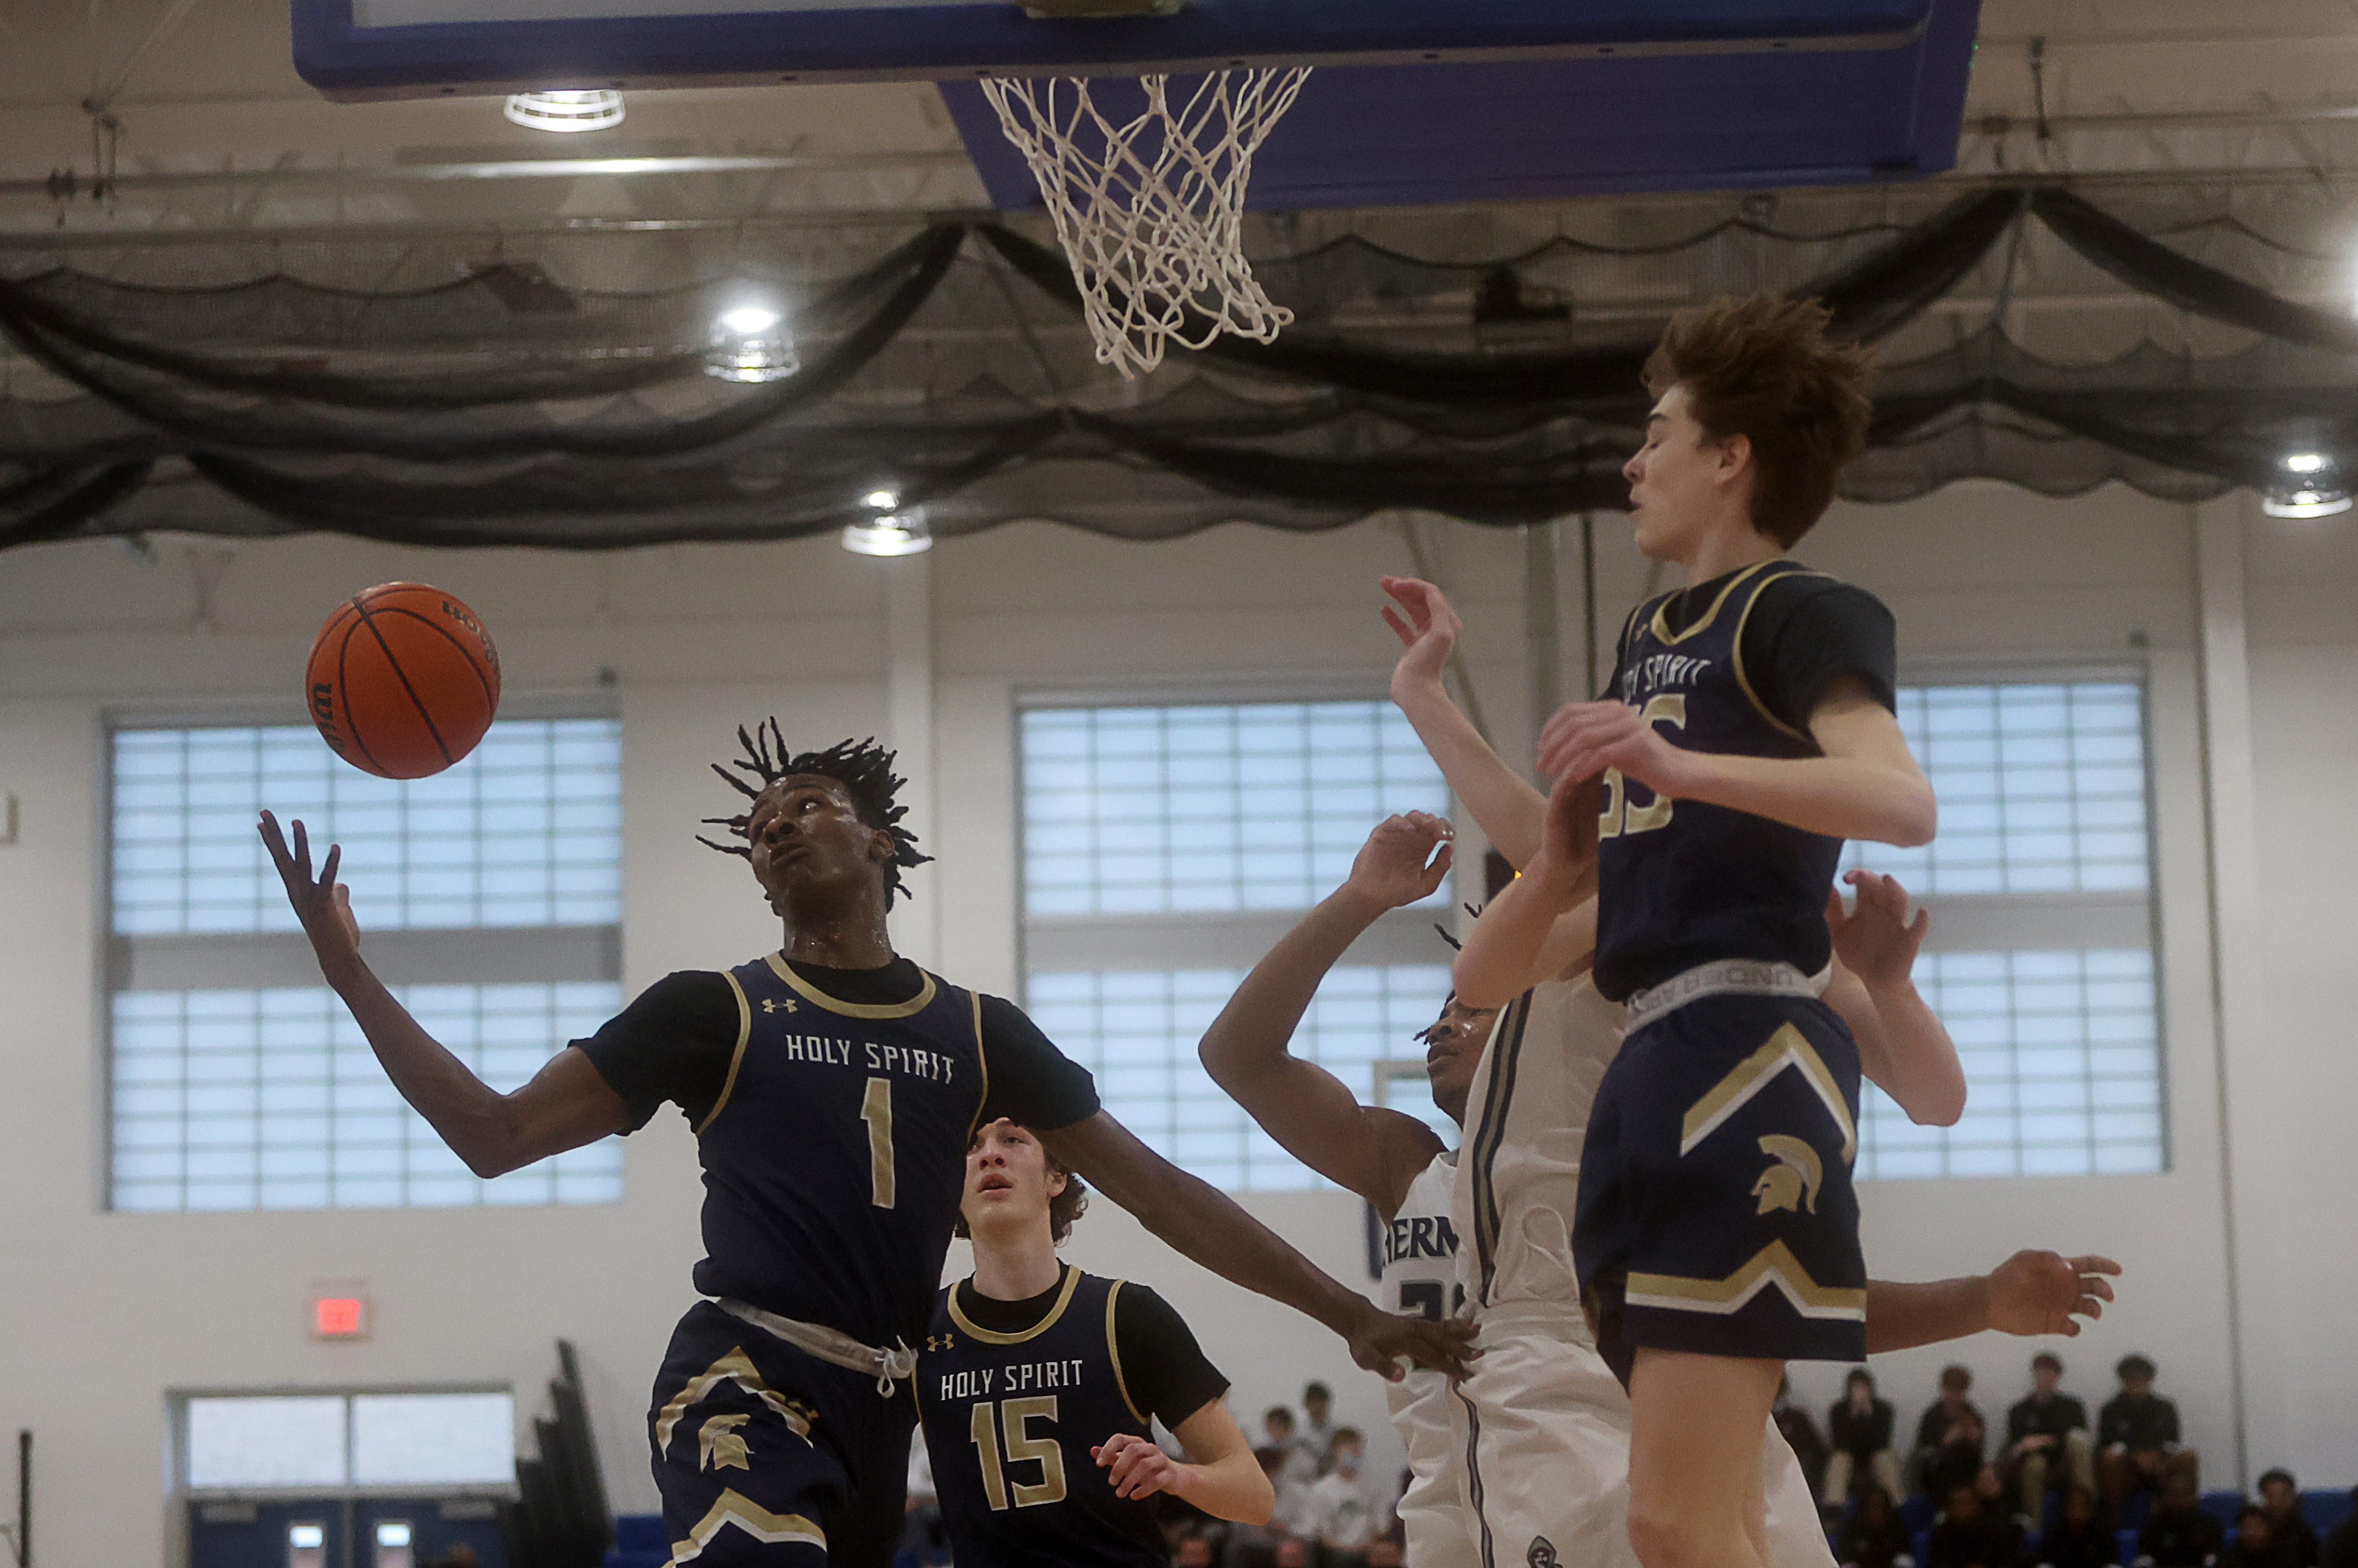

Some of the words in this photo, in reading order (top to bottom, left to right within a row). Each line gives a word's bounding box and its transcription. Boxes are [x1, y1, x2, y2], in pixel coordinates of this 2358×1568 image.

[1644, 654, 1712, 693] SPIRIT
[785, 1034, 850, 1066] HOLY
[864, 1042, 954, 1084] SPIRIT
[859, 1076, 896, 1210] 1
[941, 1368, 994, 1401] HOLY
[1004, 1360, 1083, 1391] SPIRIT
[971, 1395, 1067, 1511] 15
